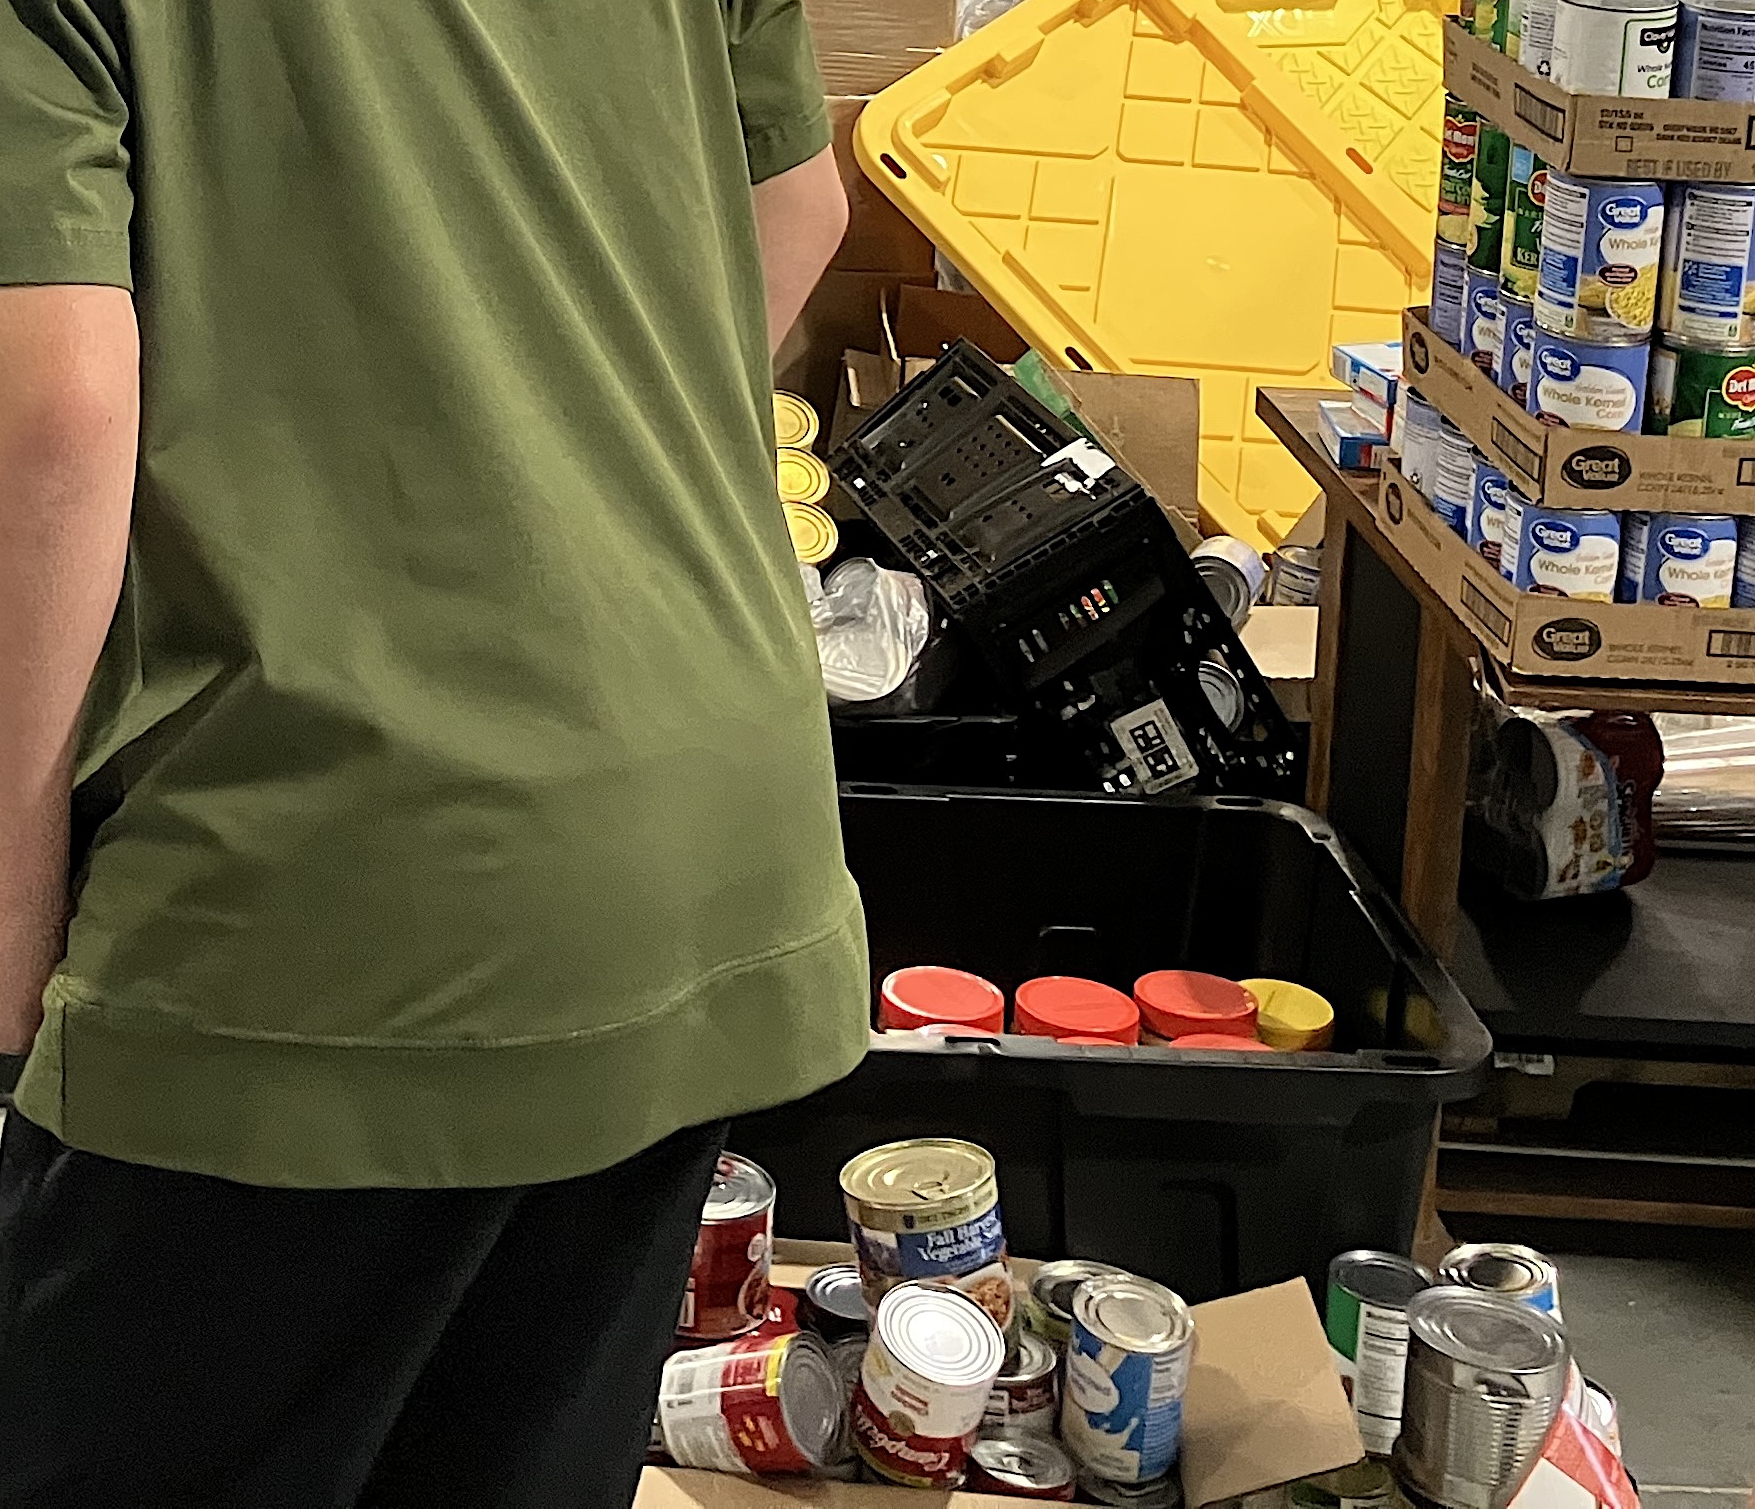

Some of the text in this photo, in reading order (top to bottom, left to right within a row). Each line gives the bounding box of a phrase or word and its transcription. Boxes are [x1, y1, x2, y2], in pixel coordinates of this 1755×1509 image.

[1626, 158, 1732, 180] BEST IF USED BY
[1605, 202, 1641, 218] Great
[1608, 237, 1648, 250] Whole
[1541, 350, 1572, 370] Great
[1542, 385, 1627, 409] Whole Kernel
[1572, 455, 1620, 473] Great
[1583, 468, 1619, 482] Value
[1534, 524, 1571, 544] Great
[1665, 532, 1703, 548] Great
[1538, 558, 1581, 575] Whole
[1667, 566, 1711, 581] Whole
[1542, 626, 1590, 645] Great
[1552, 640, 1590, 654] Value
[926, 1227, 956, 1248] Fall
